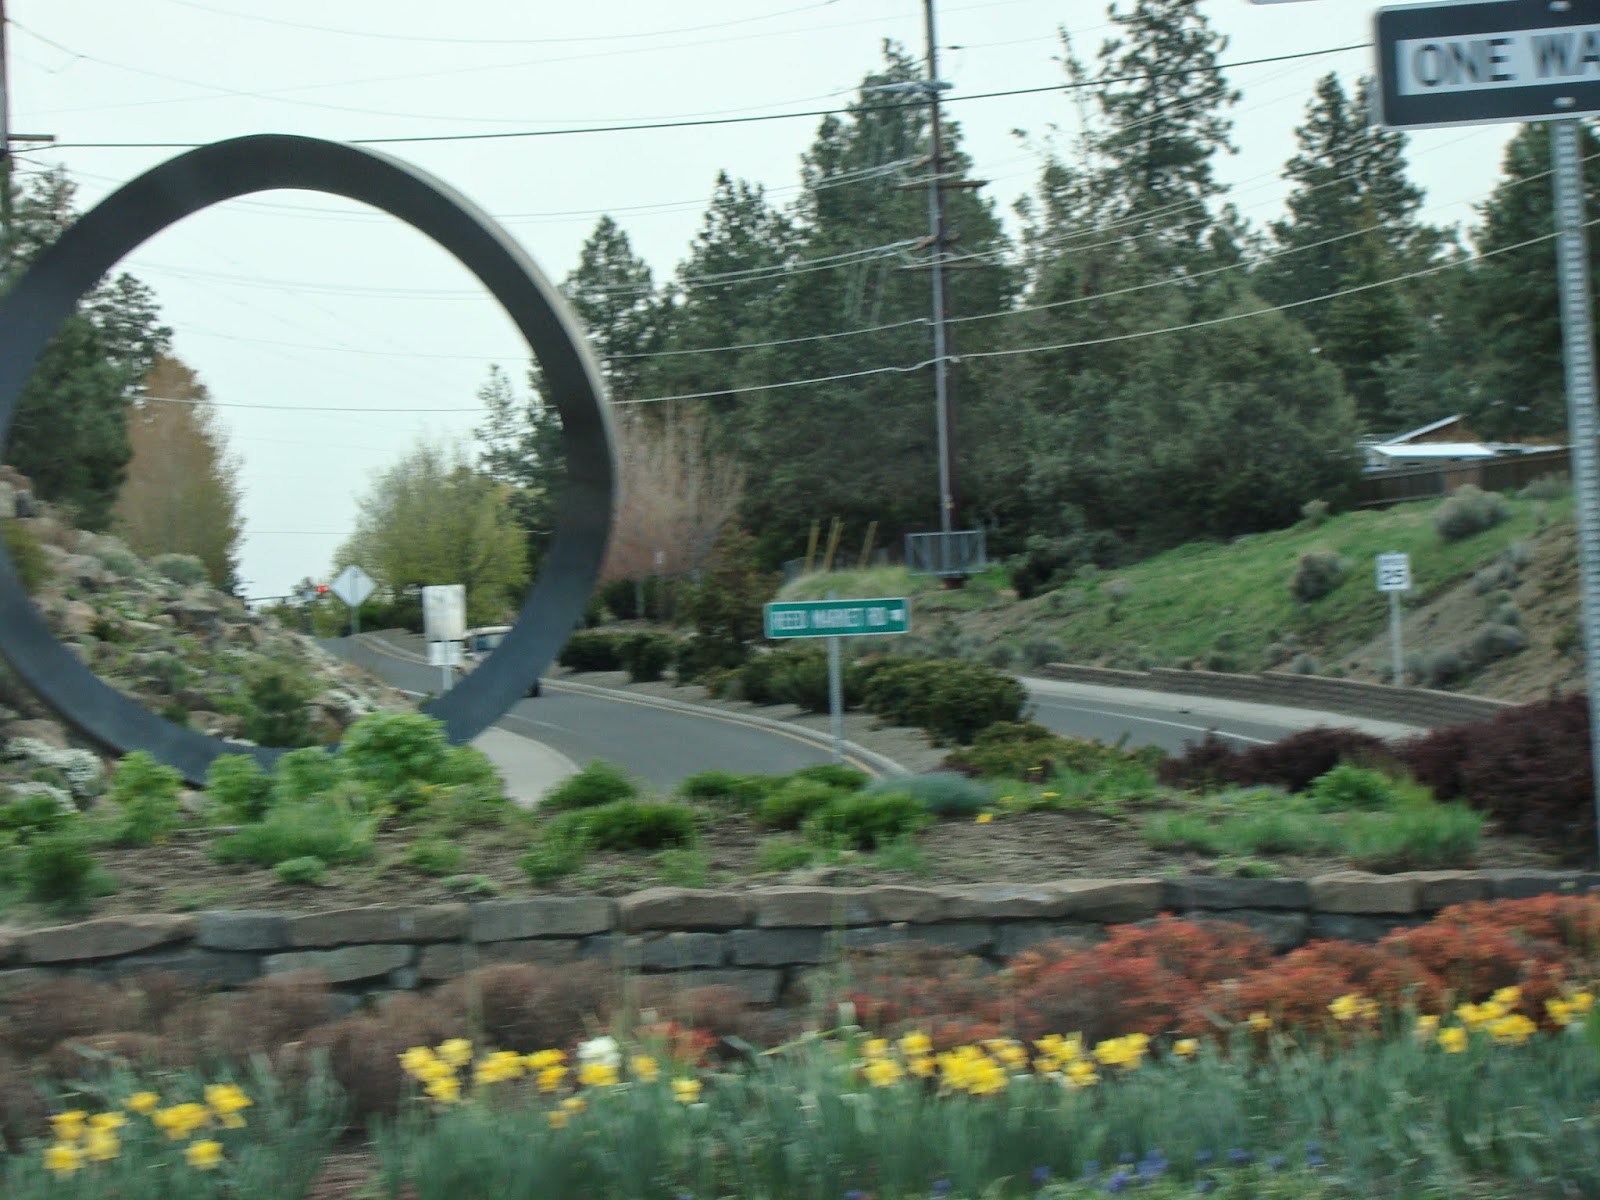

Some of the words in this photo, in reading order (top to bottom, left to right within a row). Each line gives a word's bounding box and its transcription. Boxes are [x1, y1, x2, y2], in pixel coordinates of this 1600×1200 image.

[1413, 38, 1516, 87] ONE
[1529, 31, 1600, 78] WA
[1381, 569, 1407, 585] 25
